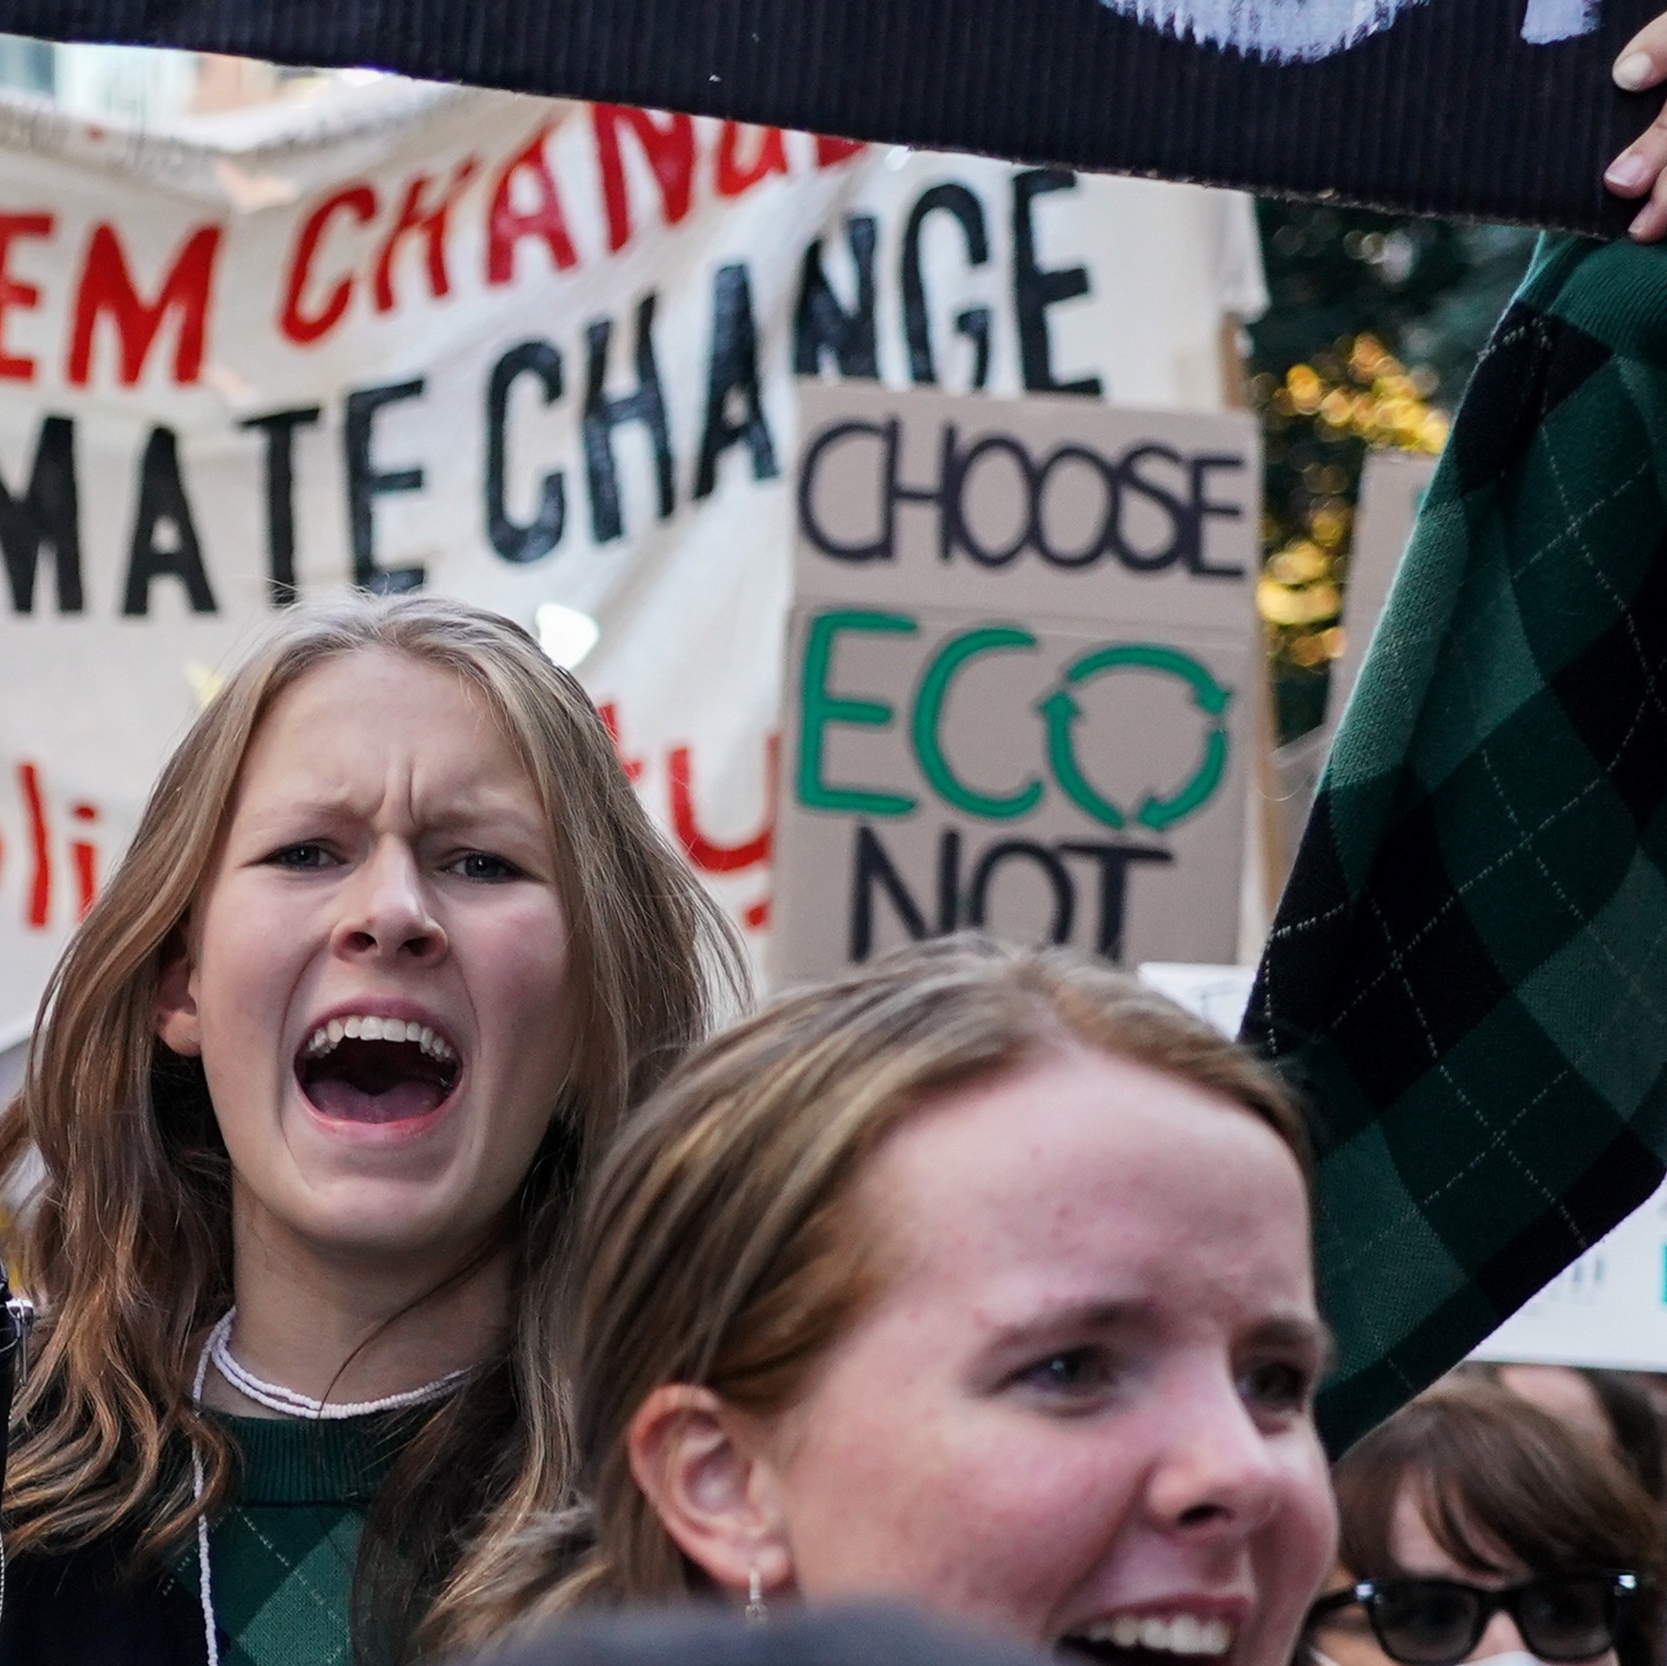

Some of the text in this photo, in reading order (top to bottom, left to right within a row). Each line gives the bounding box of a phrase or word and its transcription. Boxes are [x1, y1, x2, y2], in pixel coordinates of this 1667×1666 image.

[485, 168, 1103, 564] CHANGE
[798, 413, 1247, 581] CHOOSE
[797, 609, 1232, 832] ECO
[848, 822, 1174, 964] NOT
